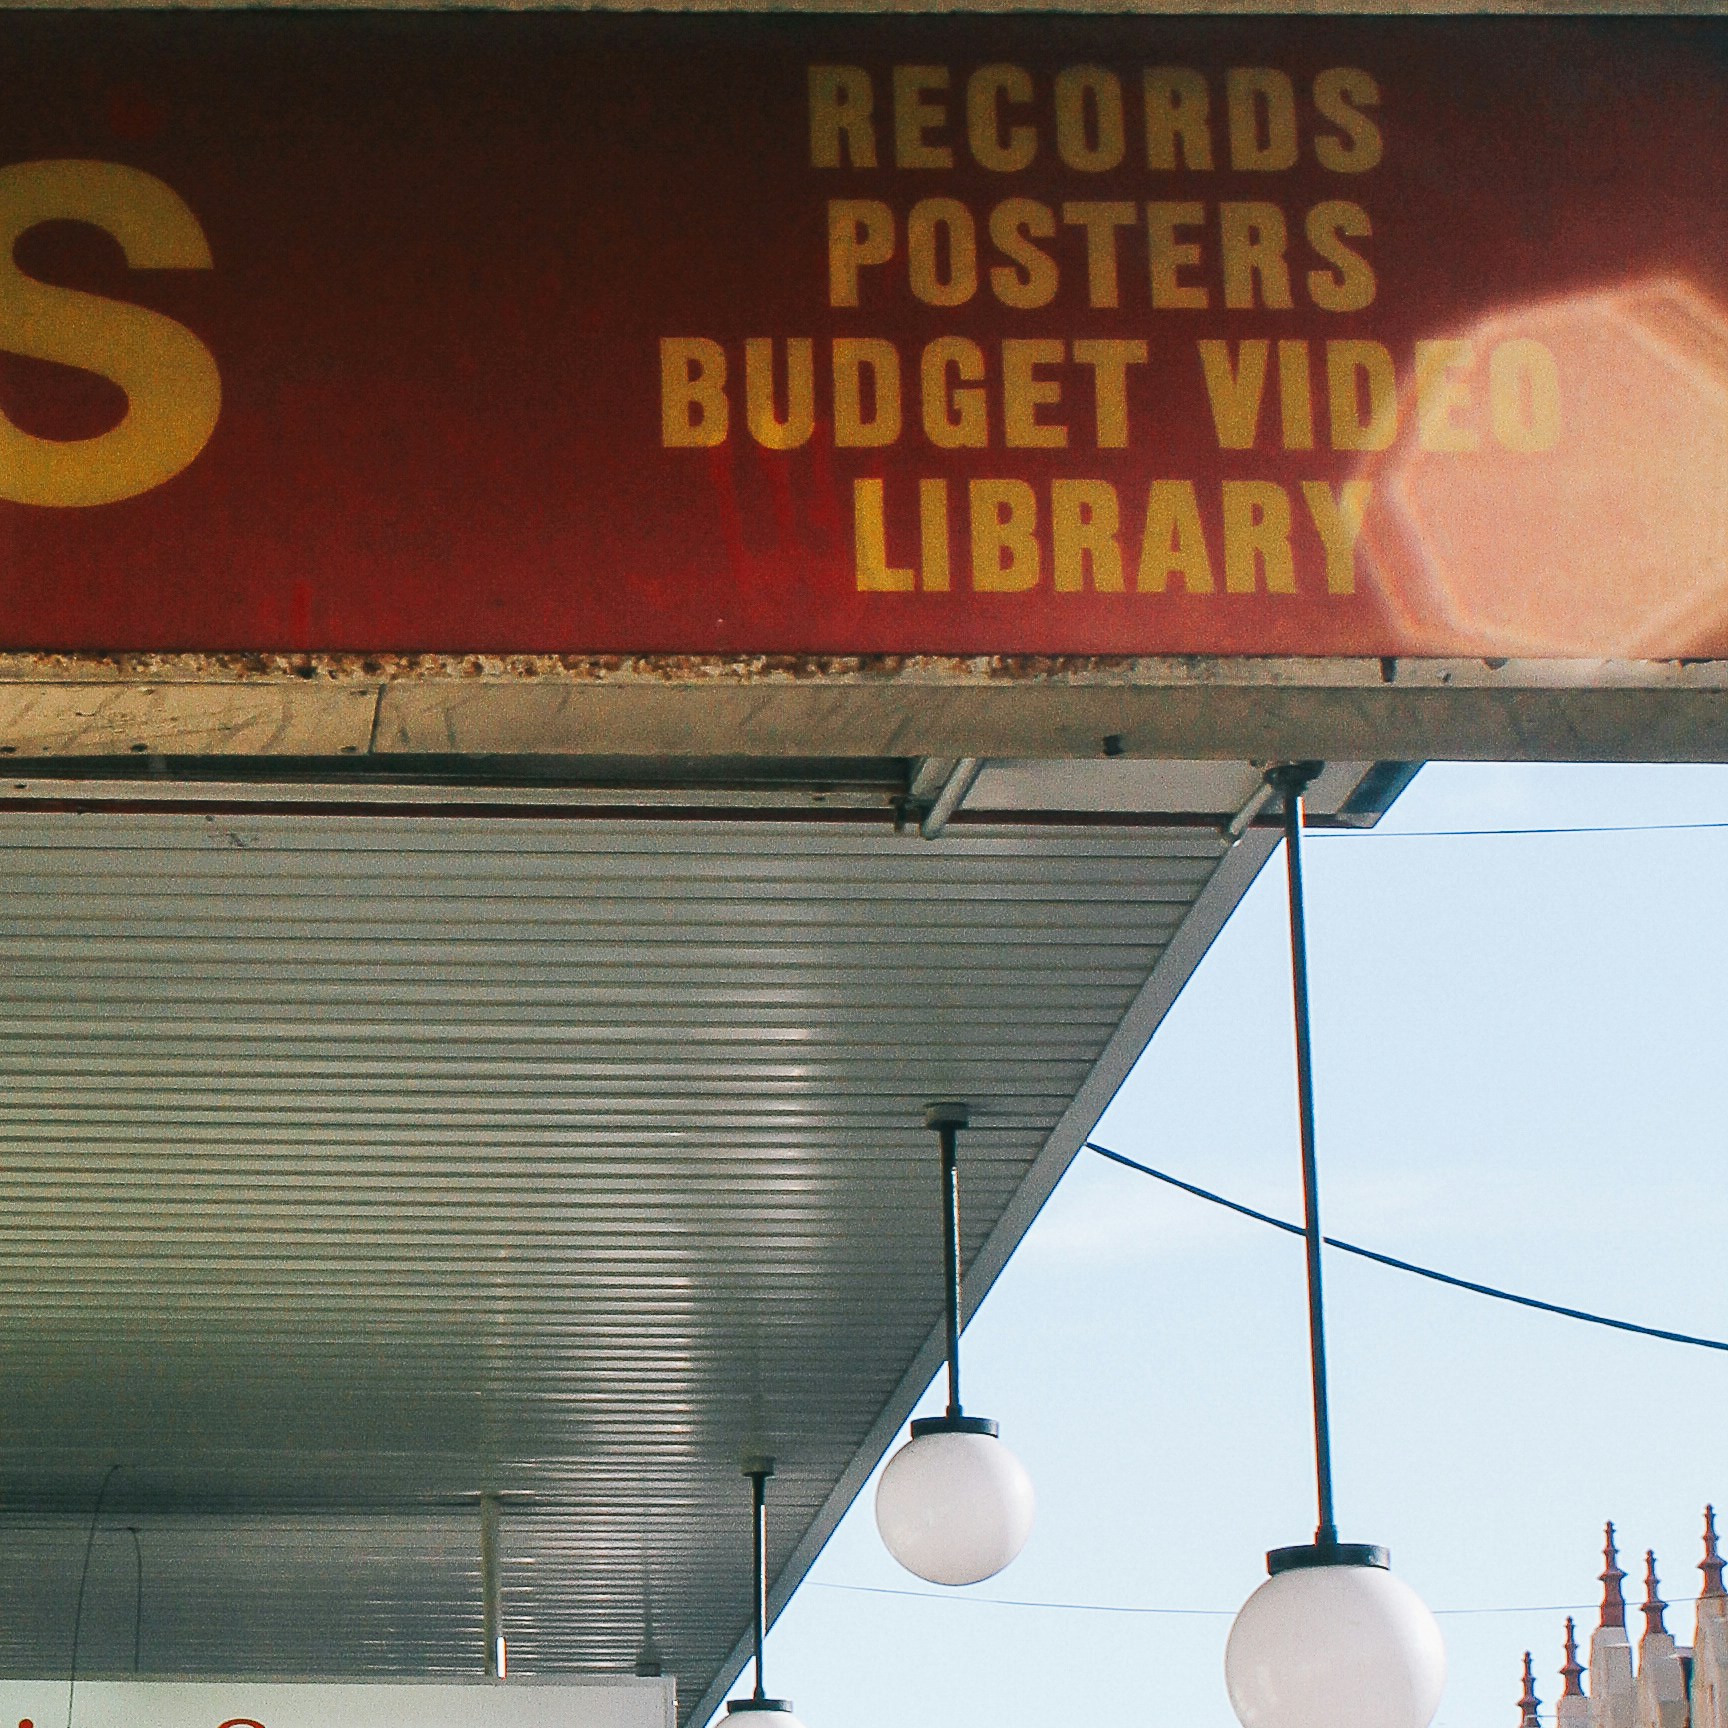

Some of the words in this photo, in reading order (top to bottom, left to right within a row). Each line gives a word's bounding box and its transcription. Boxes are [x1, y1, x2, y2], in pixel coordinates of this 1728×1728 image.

[808, 65, 1385, 174] RECORDS
[827, 198, 1378, 312] POSTERS
[658, 336, 1150, 451] BUDGET
[1197, 338, 1563, 453] VIDEO
[852, 477, 1375, 597] LIBRARY
